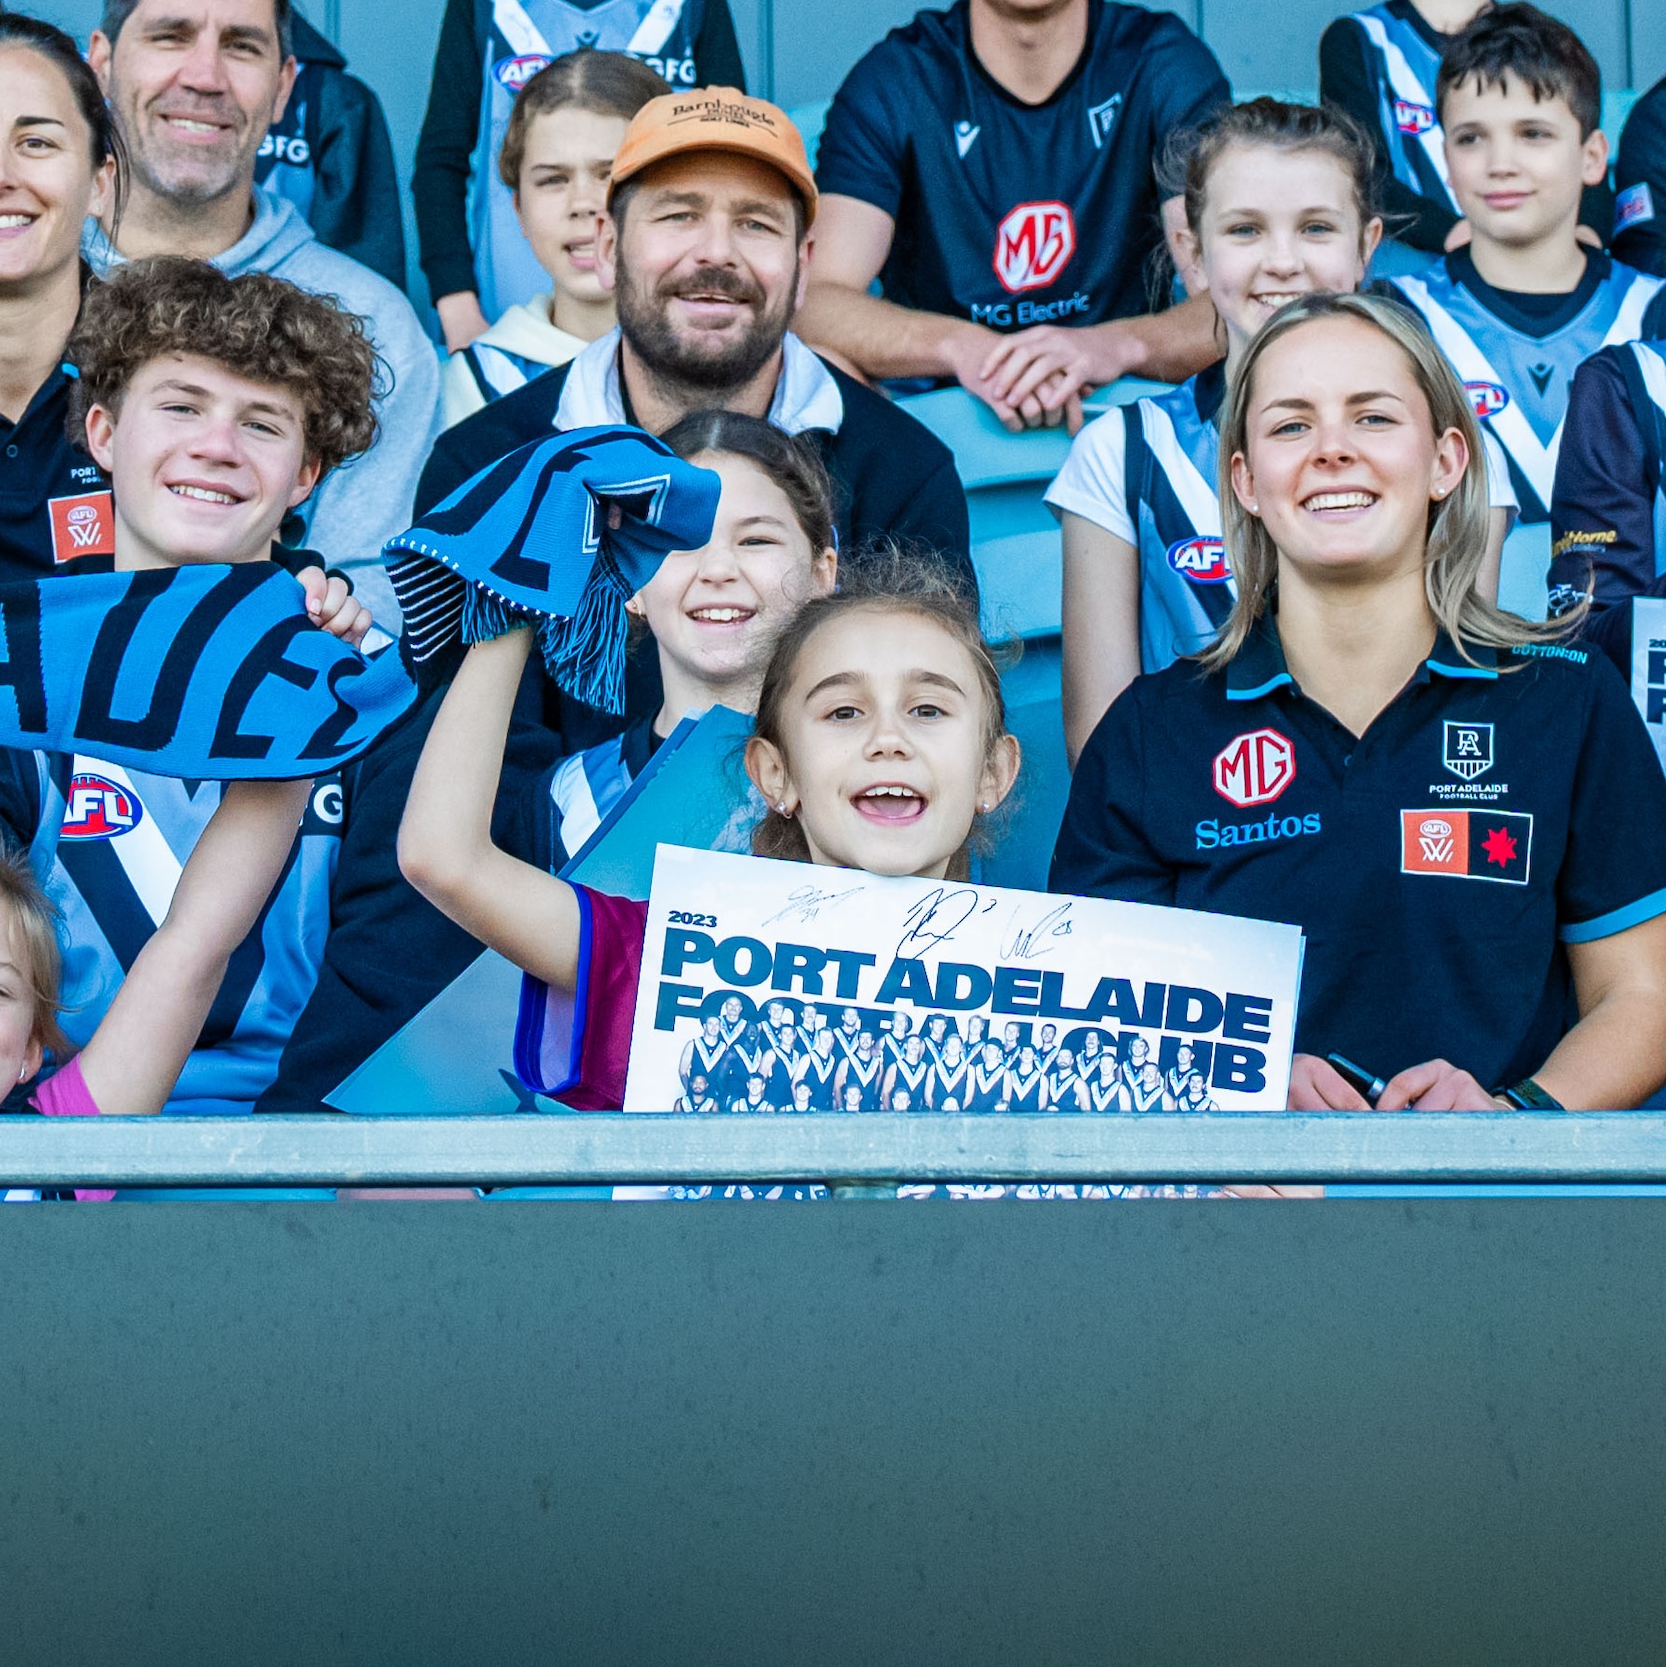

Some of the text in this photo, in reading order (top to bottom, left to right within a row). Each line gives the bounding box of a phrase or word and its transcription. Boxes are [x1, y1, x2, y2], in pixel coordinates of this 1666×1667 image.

[1004, 213, 1065, 280] MG
[970, 291, 1090, 327] MG Electric
[1468, 388, 1504, 409] FL
[1220, 734, 1287, 800] MG
[1429, 783, 1509, 794] PORT ADELAIDE
[1195, 811, 1322, 851] Santos
[667, 910, 718, 928] 2023
[661, 926, 1274, 1045] PORT ADELAIDE
